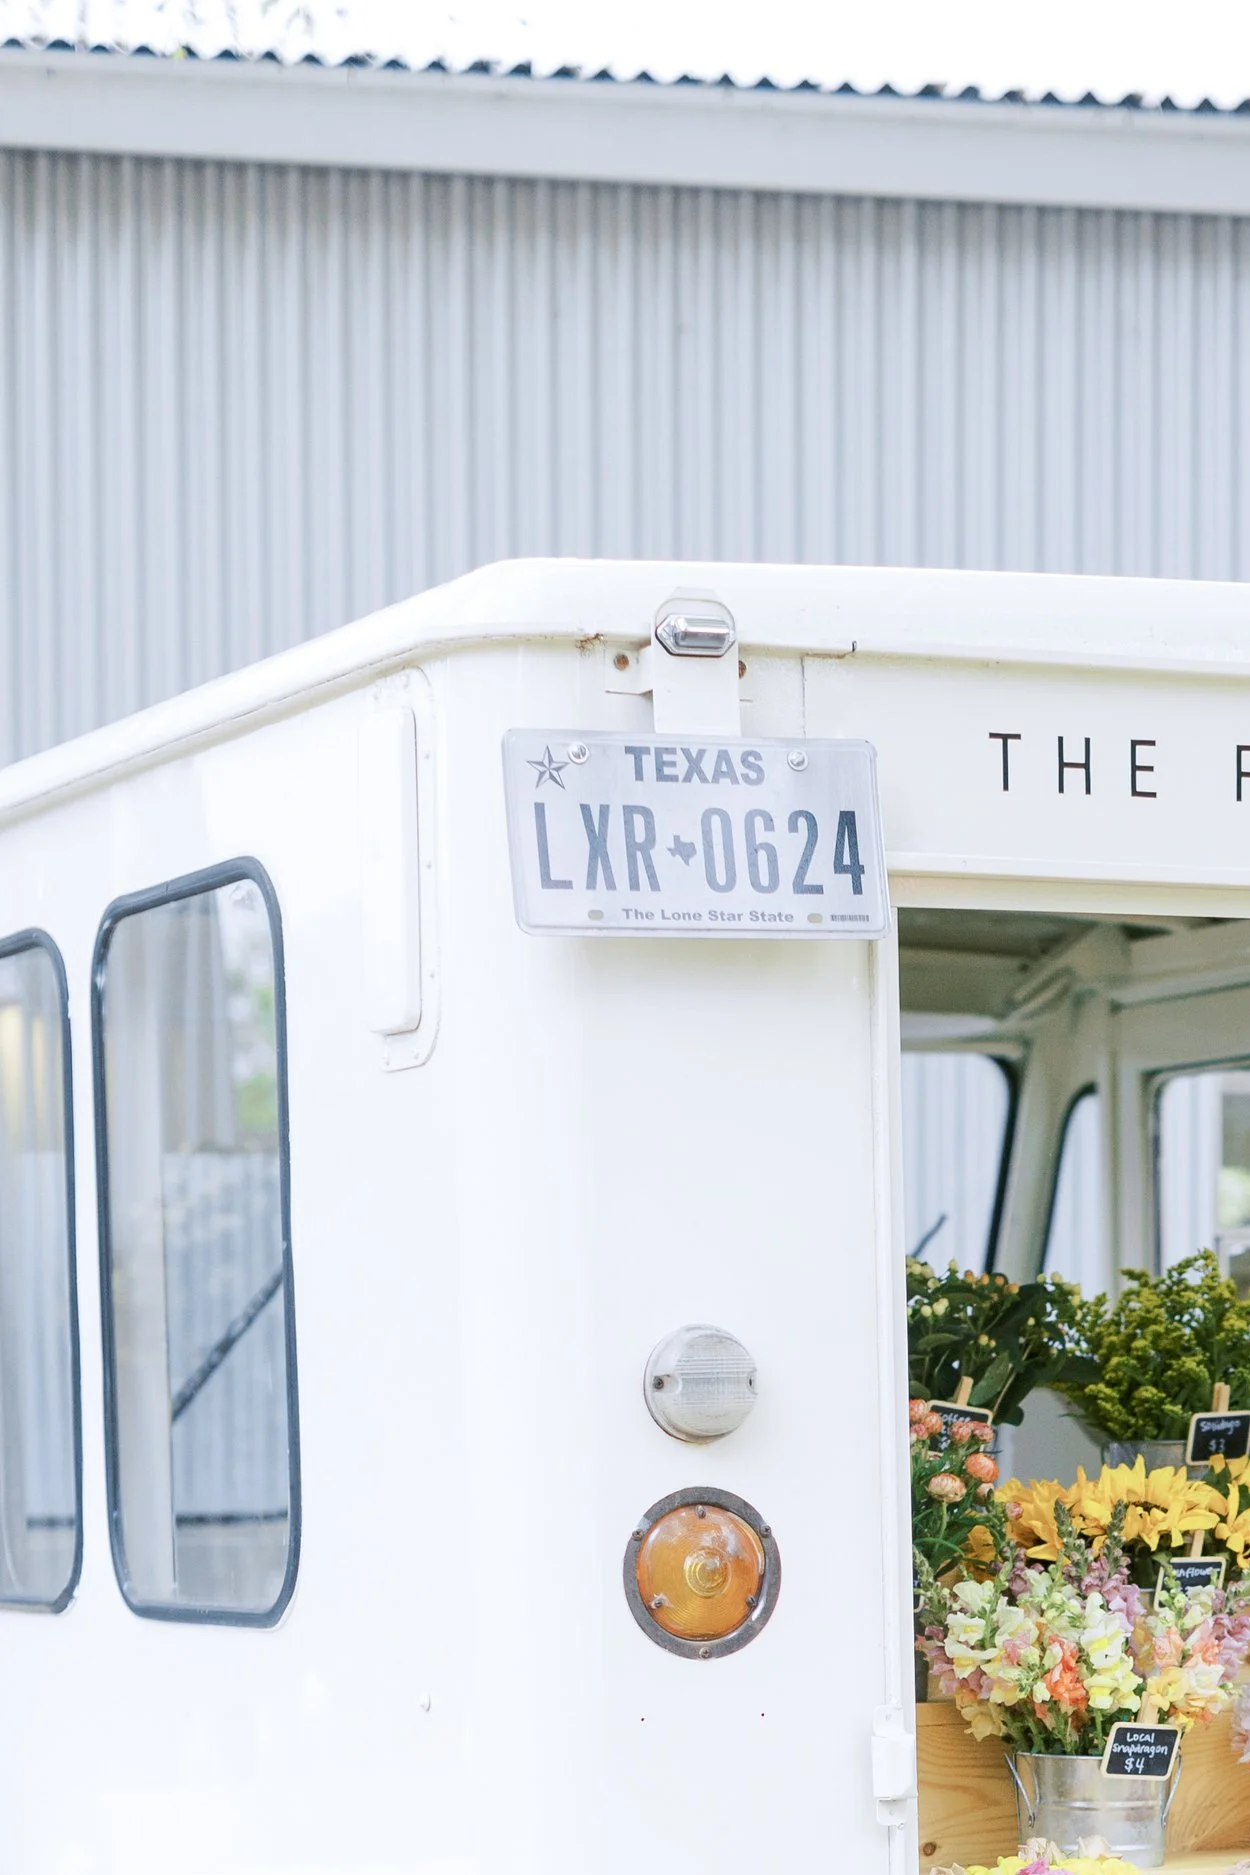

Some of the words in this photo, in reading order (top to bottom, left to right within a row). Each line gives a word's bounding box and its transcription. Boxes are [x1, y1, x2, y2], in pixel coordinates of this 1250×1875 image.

[624, 745, 765, 786] TEXAS
[989, 732, 1157, 799] THE
[621, 908, 655, 921] The
[660, 909, 703, 922] Lone
[708, 910, 744, 923] Star
[749, 911, 794, 923] State
[1126, 1732, 1156, 1744] Local
[1124, 1757, 1146, 1774] $4
